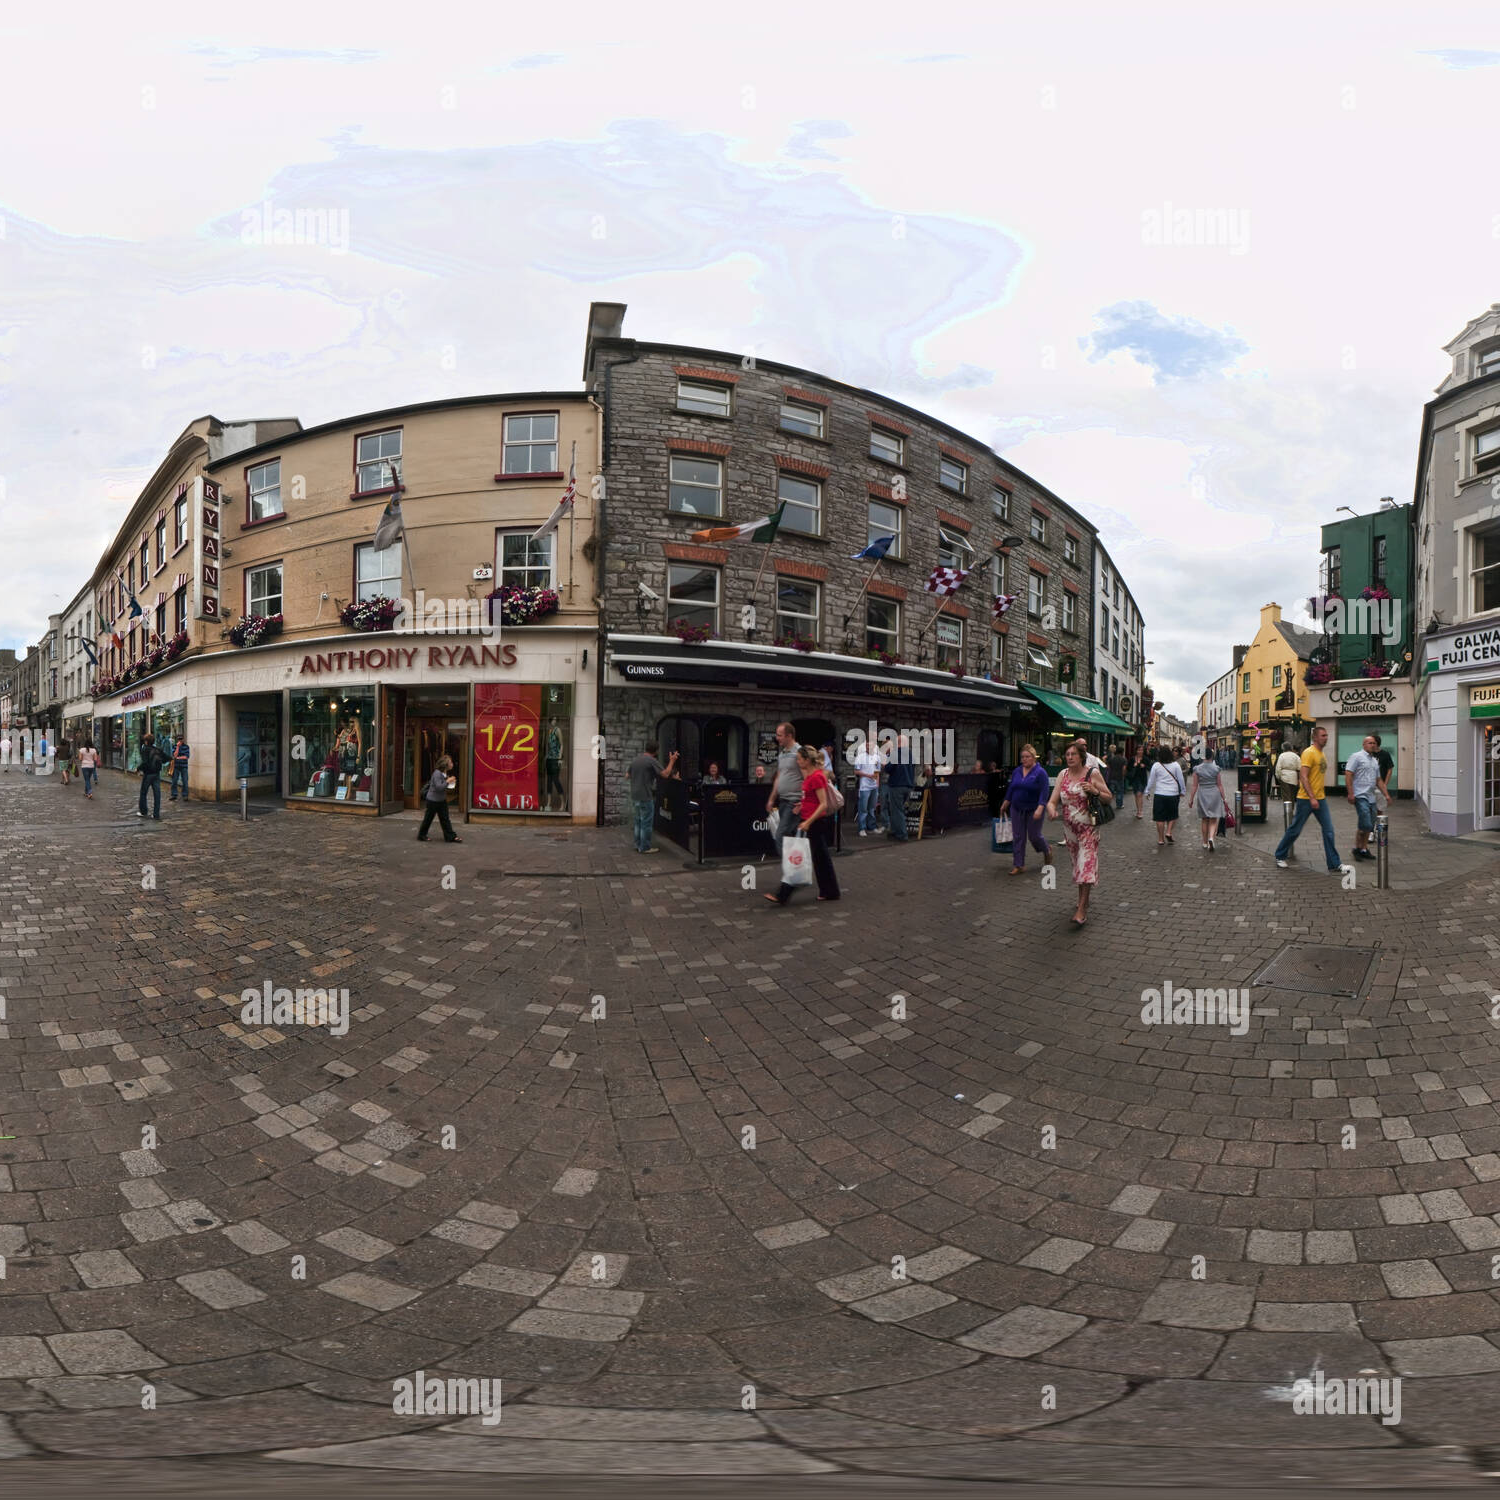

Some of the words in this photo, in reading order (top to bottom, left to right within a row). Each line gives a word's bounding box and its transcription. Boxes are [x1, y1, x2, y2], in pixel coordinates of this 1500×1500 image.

[204, 484, 217, 615] RYANS
[1454, 630, 1500, 649] GALWA
[300, 647, 419, 674] ANTHONY
[428, 644, 518, 668] RYANS
[1442, 650, 1468, 665] FUJI
[1472, 644, 1500, 660] CEN
[626, 664, 665, 675] GUINNESS
[1329, 687, 1396, 706] Claddagh
[1333, 702, 1387, 716] Jewellers
[480, 723, 534, 752] 1/2
[478, 793, 533, 810] SALE
